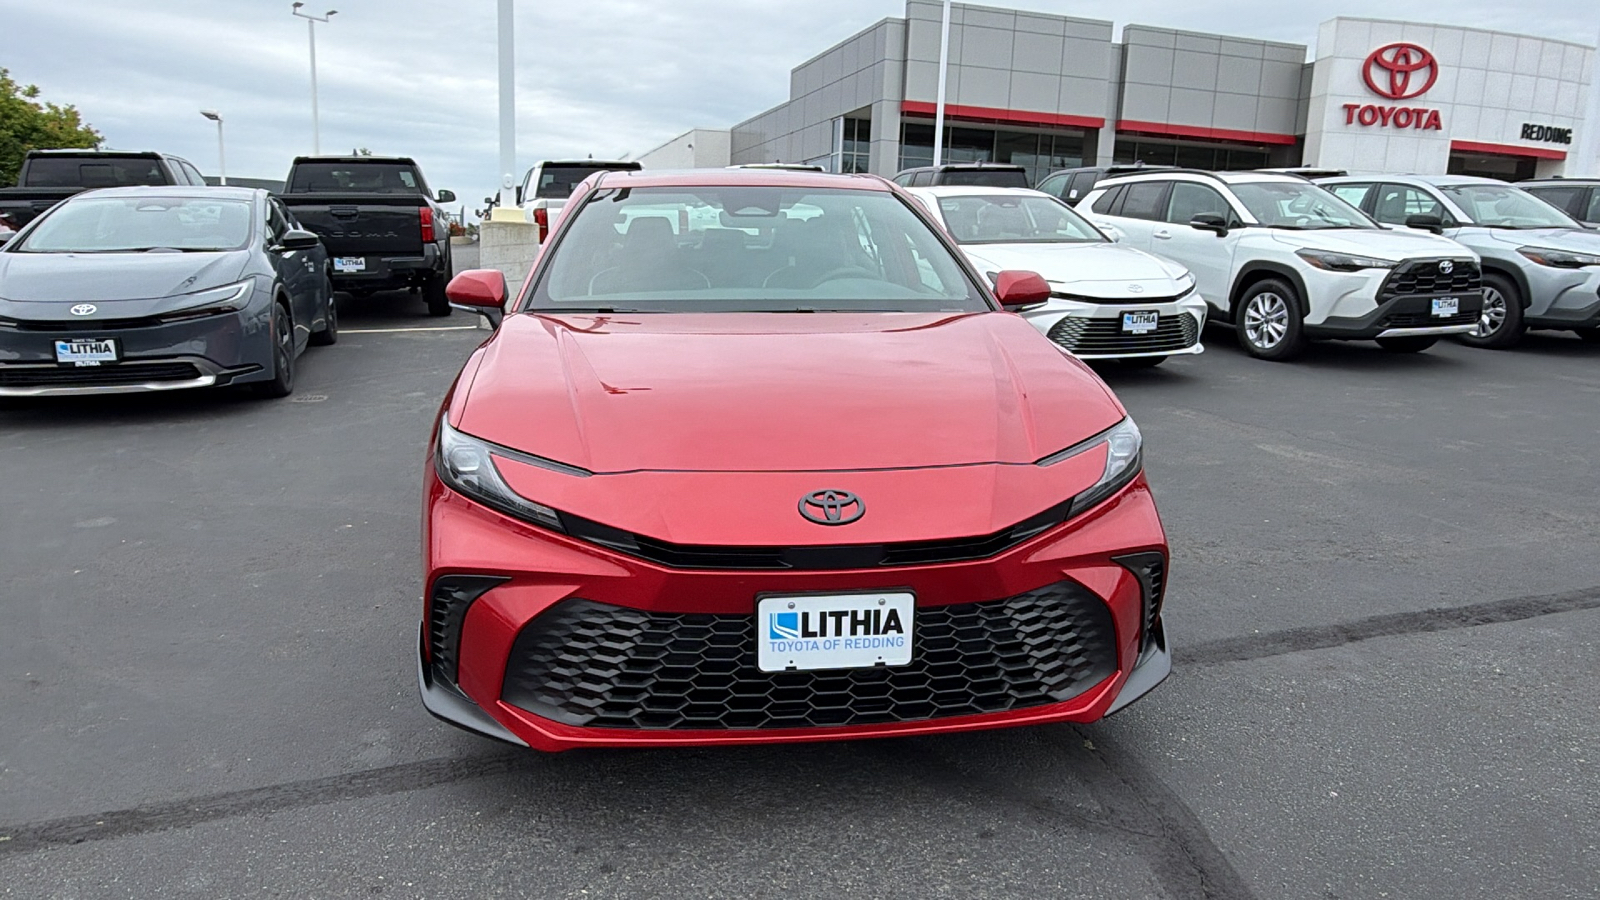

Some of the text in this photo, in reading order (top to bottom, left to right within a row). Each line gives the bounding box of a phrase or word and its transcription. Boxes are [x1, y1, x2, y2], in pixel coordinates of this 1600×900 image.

[1342, 104, 1442, 130] TOYOTA
[1521, 123, 1572, 144] REDDING
[1131, 315, 1156, 324] LITHIA
[70, 343, 112, 354] LITHIA
[801, 608, 904, 638] LITHIA
[769, 637, 904, 652] TOYOTA OF REDDING
